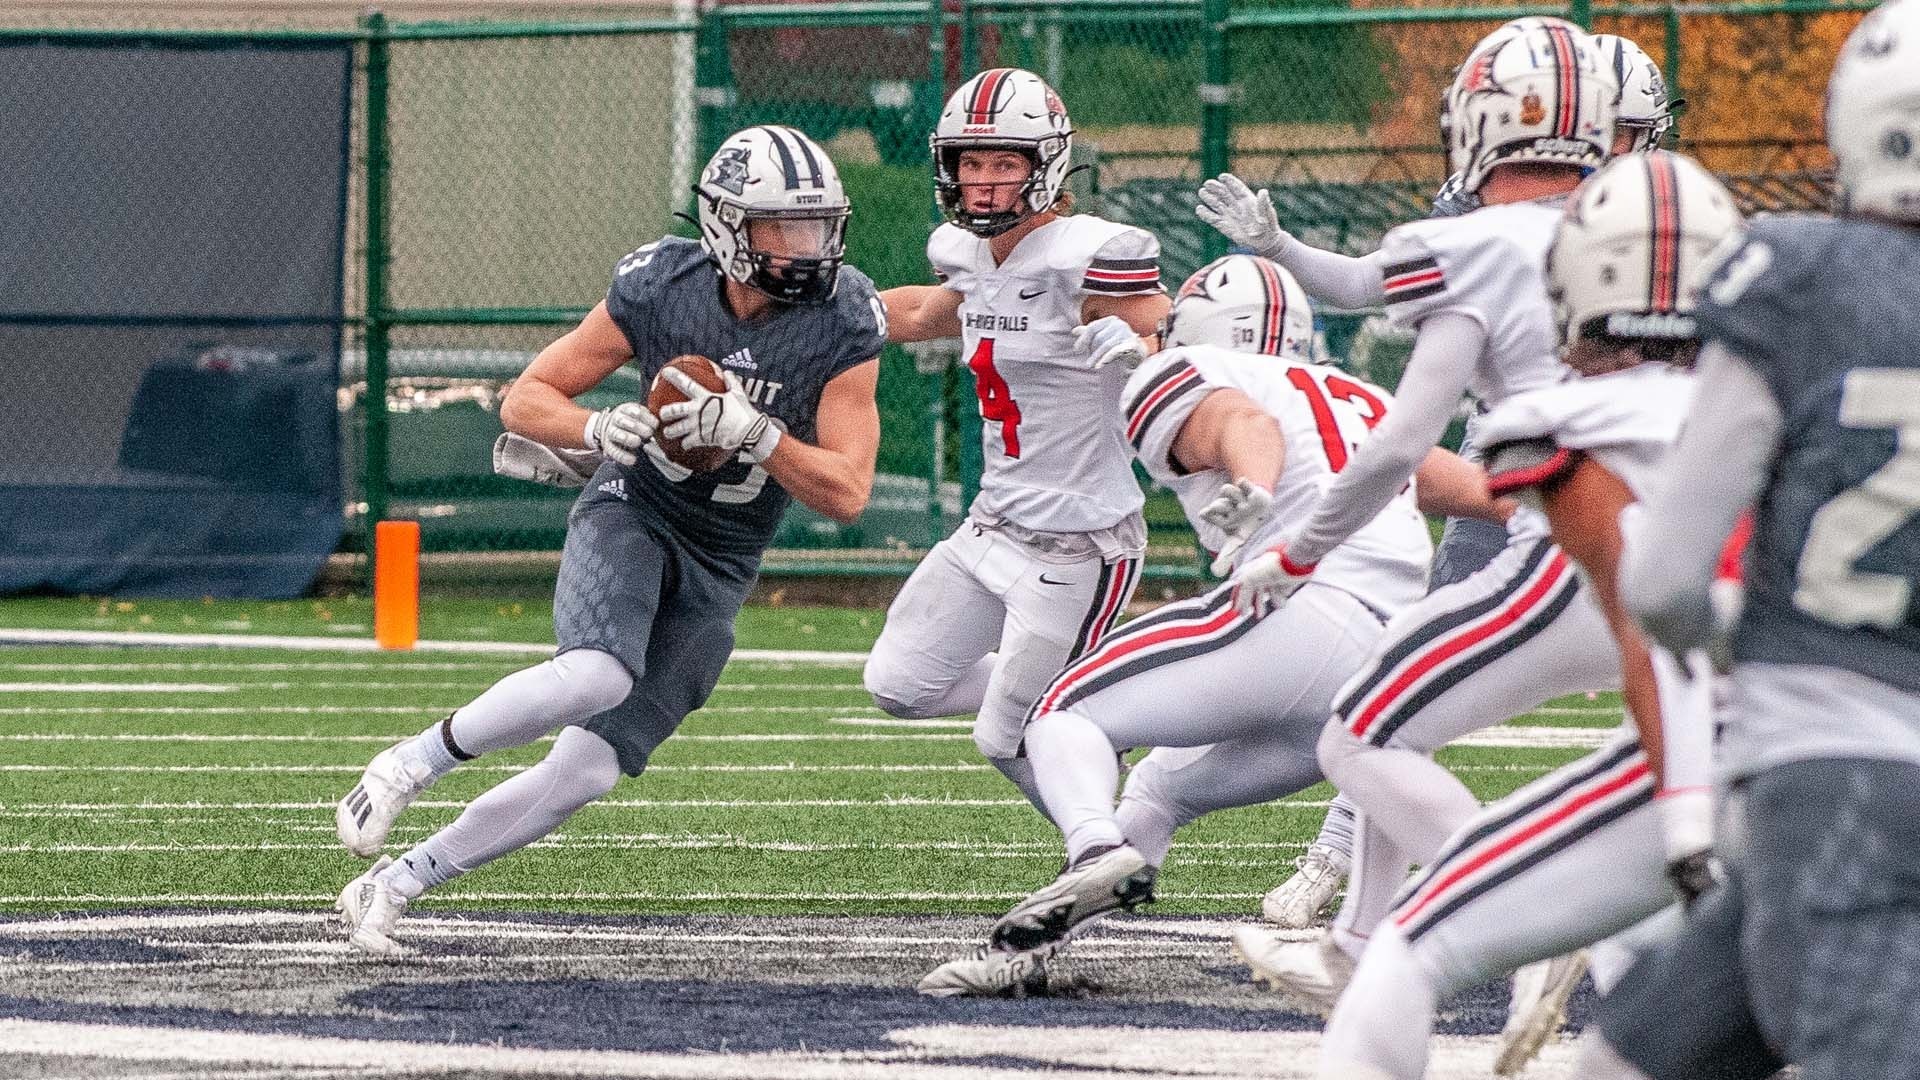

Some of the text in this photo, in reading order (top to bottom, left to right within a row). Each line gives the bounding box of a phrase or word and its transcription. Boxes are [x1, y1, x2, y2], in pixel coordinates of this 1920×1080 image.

[796, 194, 822, 204] STOUT
[999, 315, 1028, 331] FALLS
[968, 338, 1022, 459] 4
